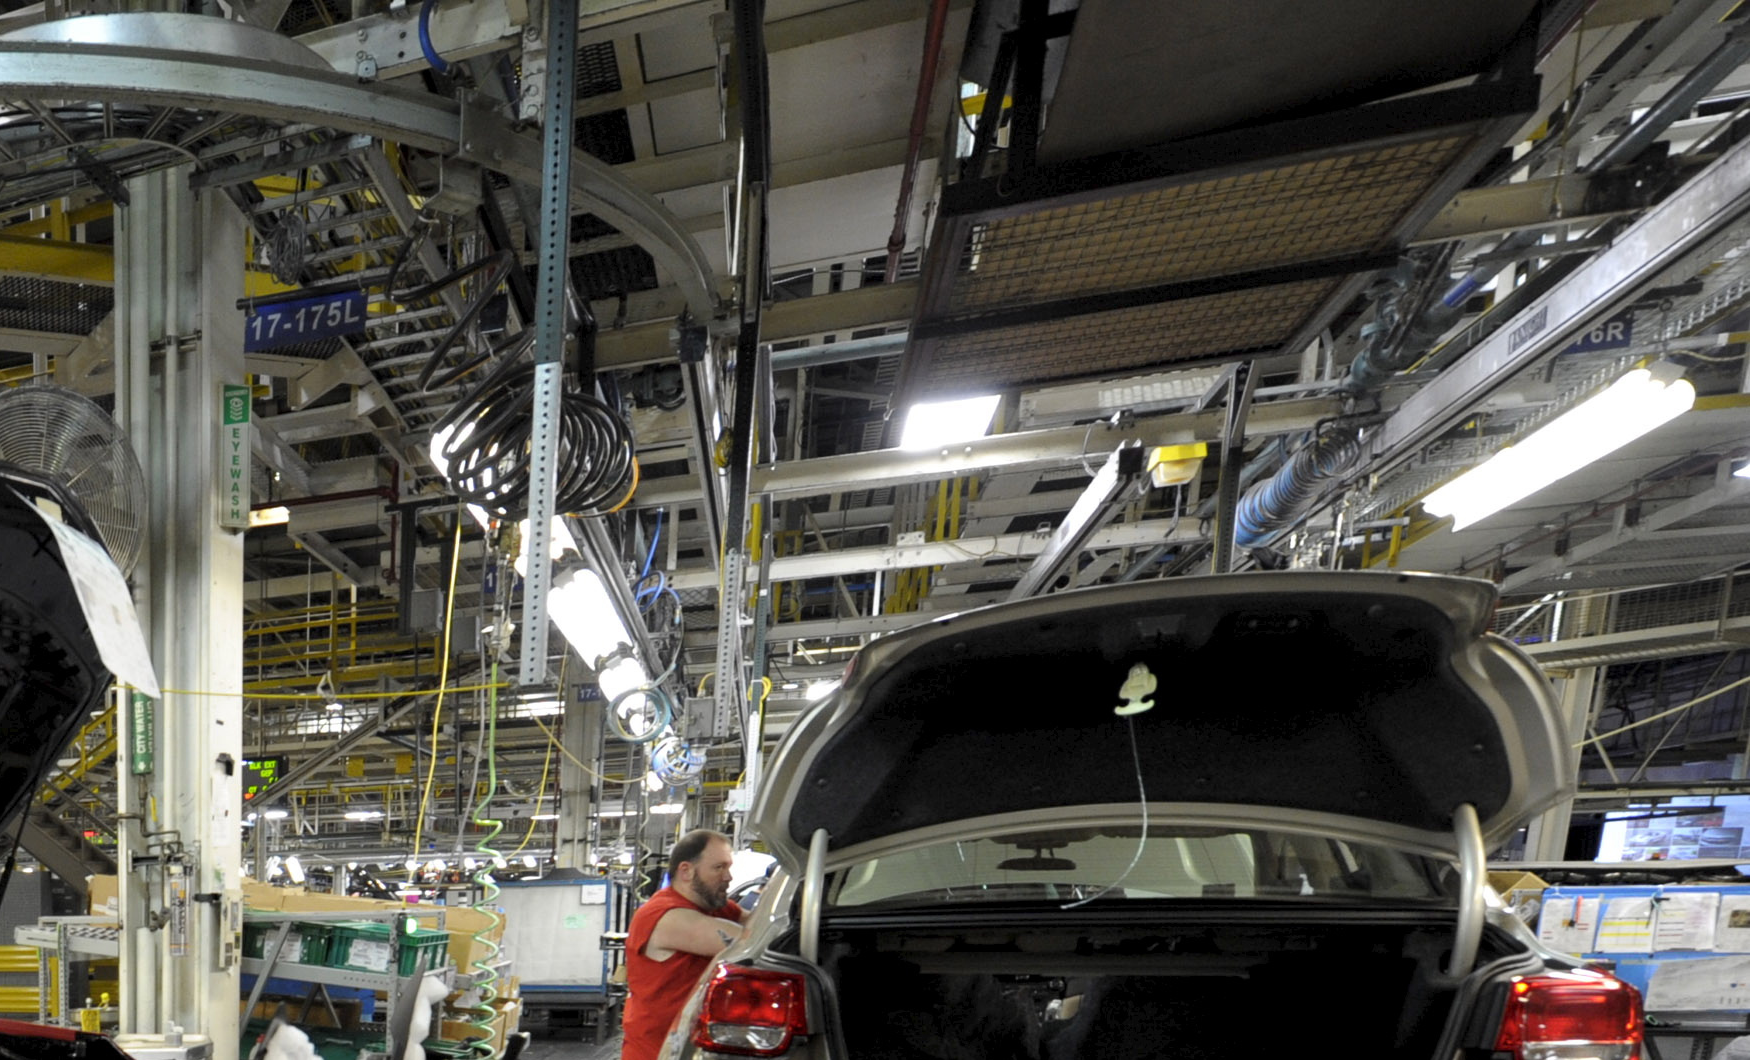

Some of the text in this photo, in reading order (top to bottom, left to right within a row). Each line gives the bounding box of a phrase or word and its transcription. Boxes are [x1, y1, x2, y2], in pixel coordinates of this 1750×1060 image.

[252, 299, 359, 340] 17-175L
[230, 428, 241, 519] EYEWASH
[134, 701, 145, 733] WATER
